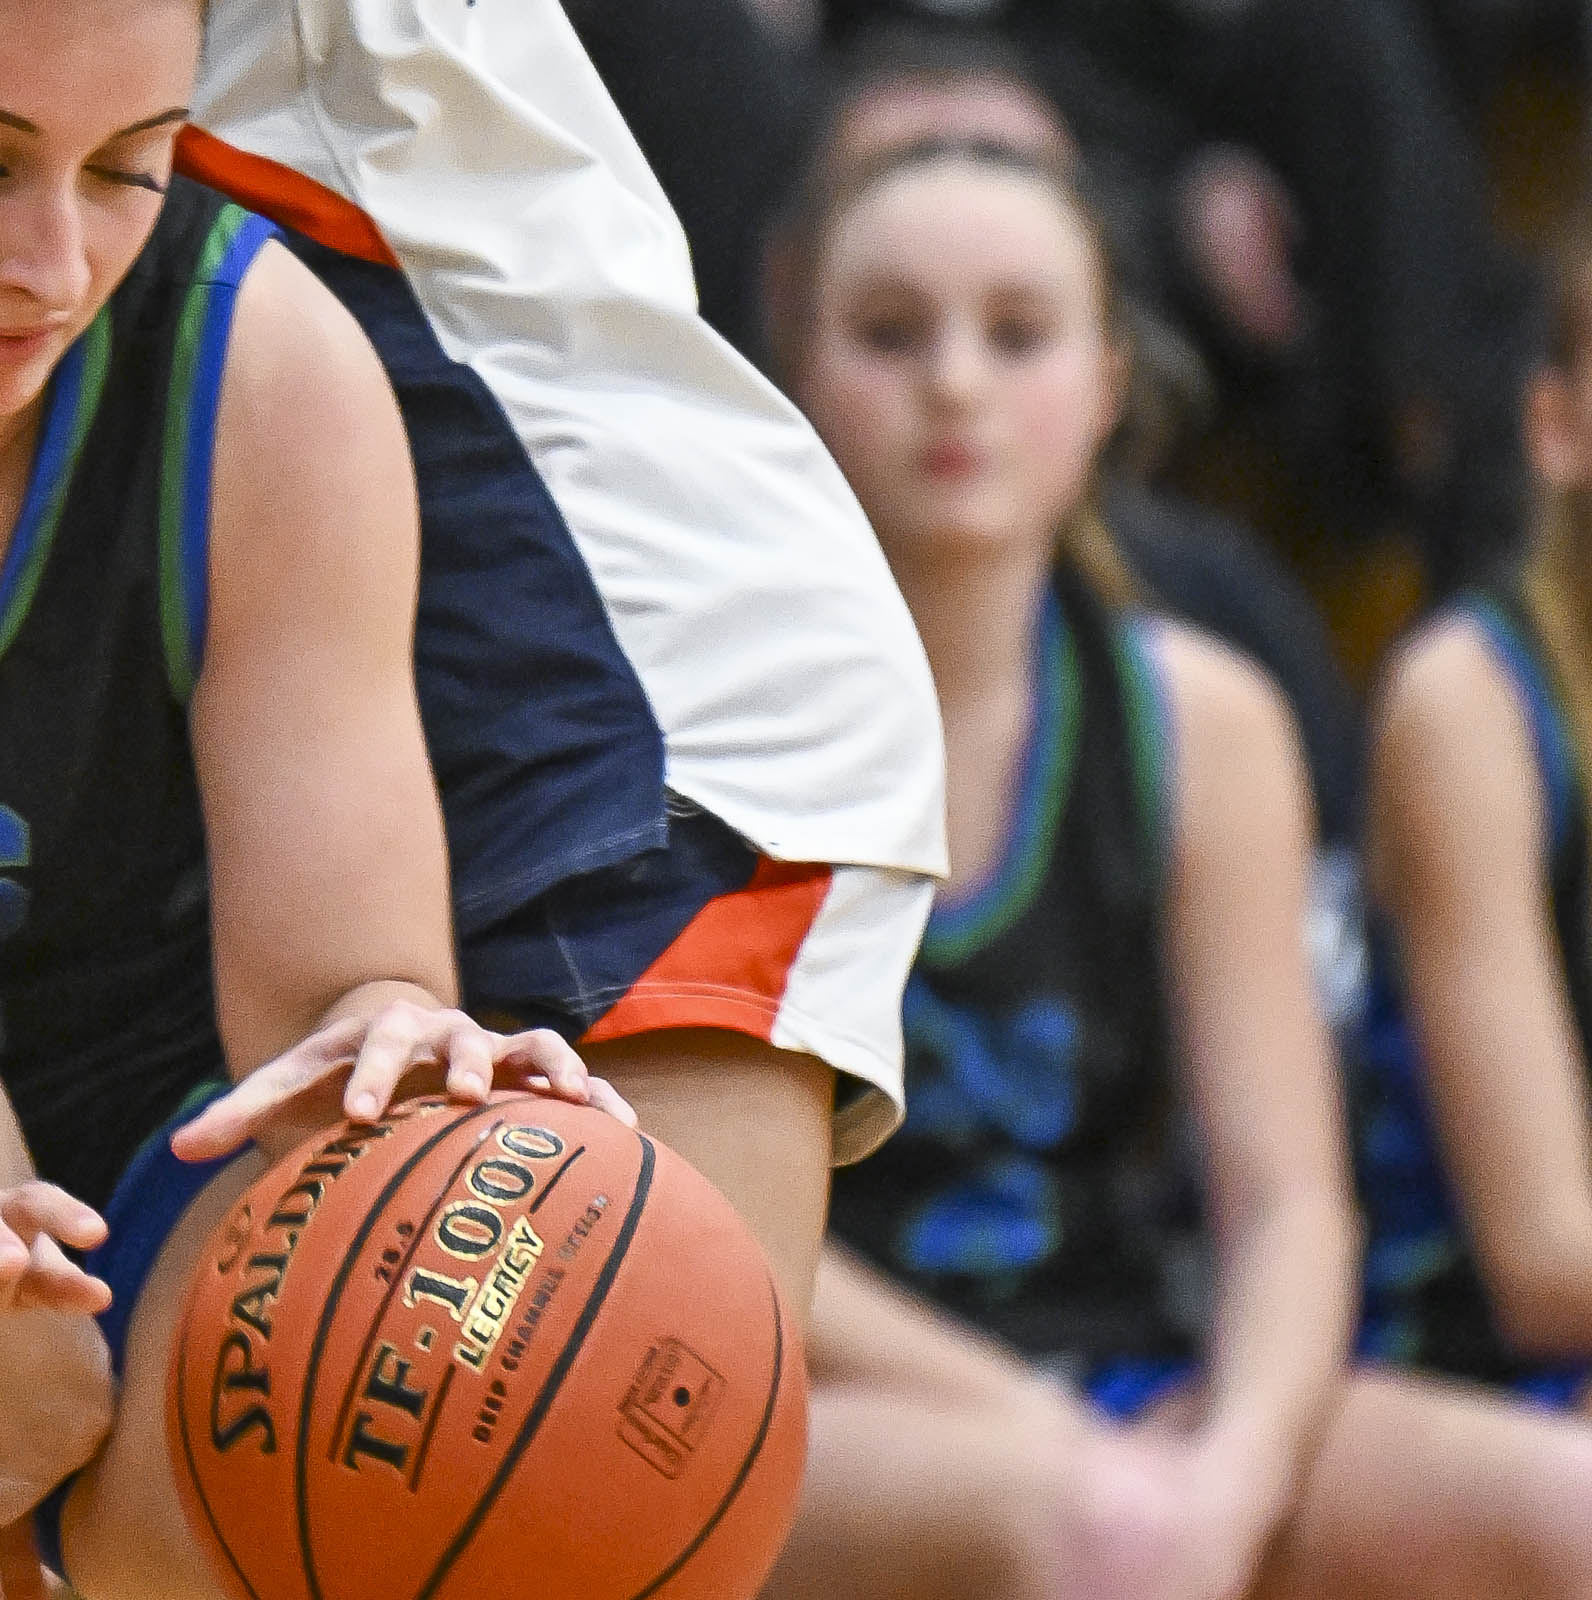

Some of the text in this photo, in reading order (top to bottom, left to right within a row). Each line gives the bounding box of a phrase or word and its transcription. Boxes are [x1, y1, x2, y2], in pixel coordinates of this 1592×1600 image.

[211, 1098, 447, 1456] SPALDIN
[344, 1125, 564, 1476] TF-1000
[455, 1215, 544, 1372] LEGACY
